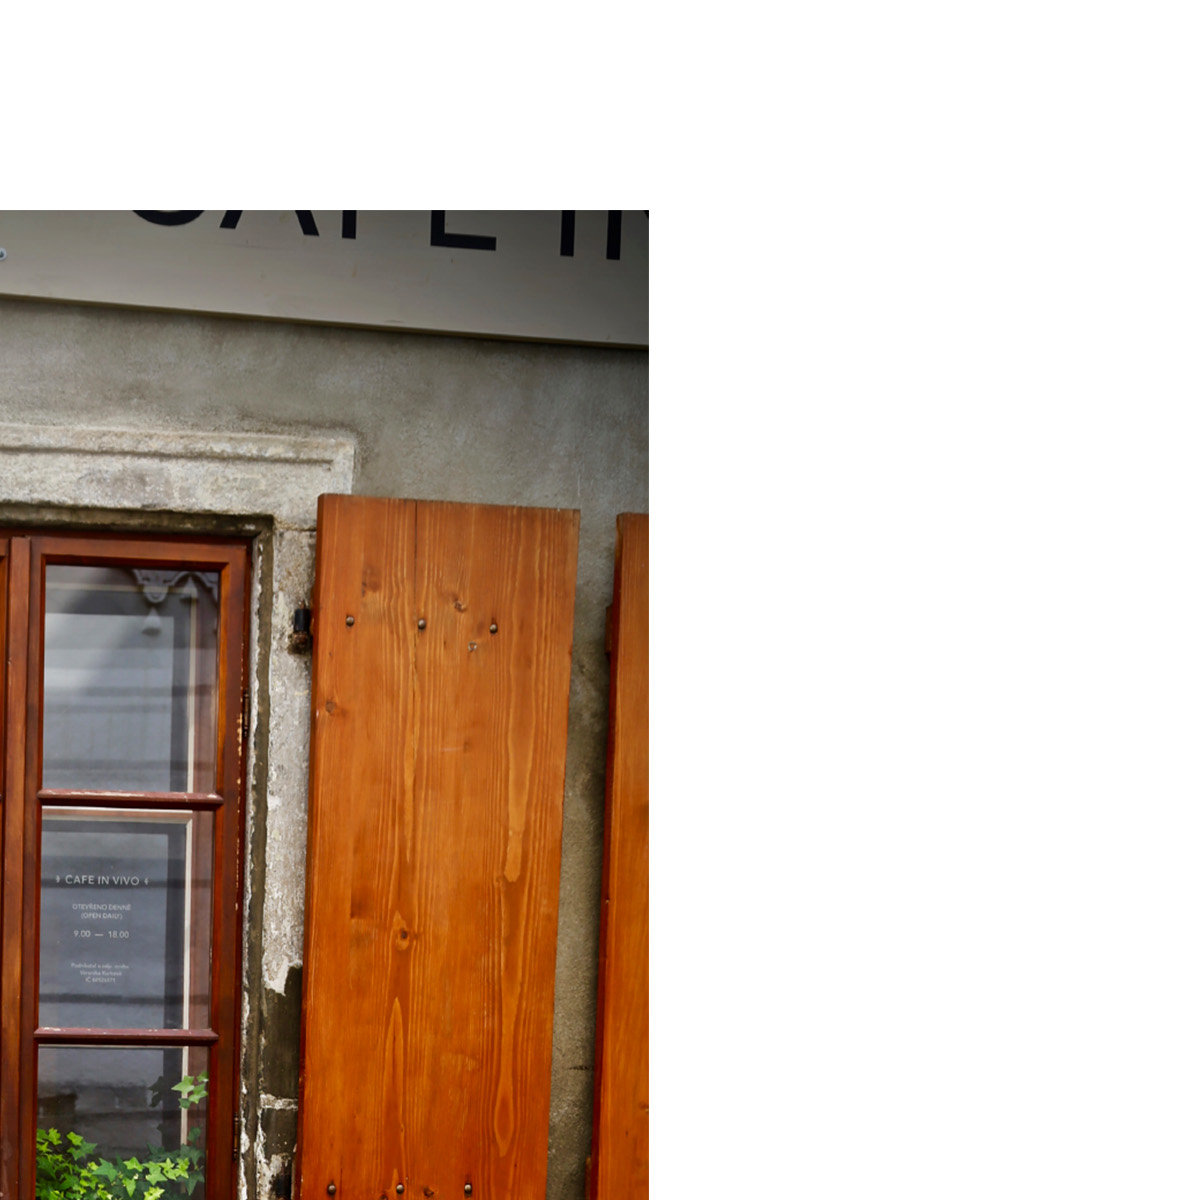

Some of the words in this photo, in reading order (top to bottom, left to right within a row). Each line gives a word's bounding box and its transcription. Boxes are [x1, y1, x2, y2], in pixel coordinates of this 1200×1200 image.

[65, 874, 95, 885] CAFE
[97, 876, 109, 885] IN
[112, 876, 140, 886] VIVO
[73, 930, 91, 938] 9.00
[108, 930, 130, 939] 18.00
